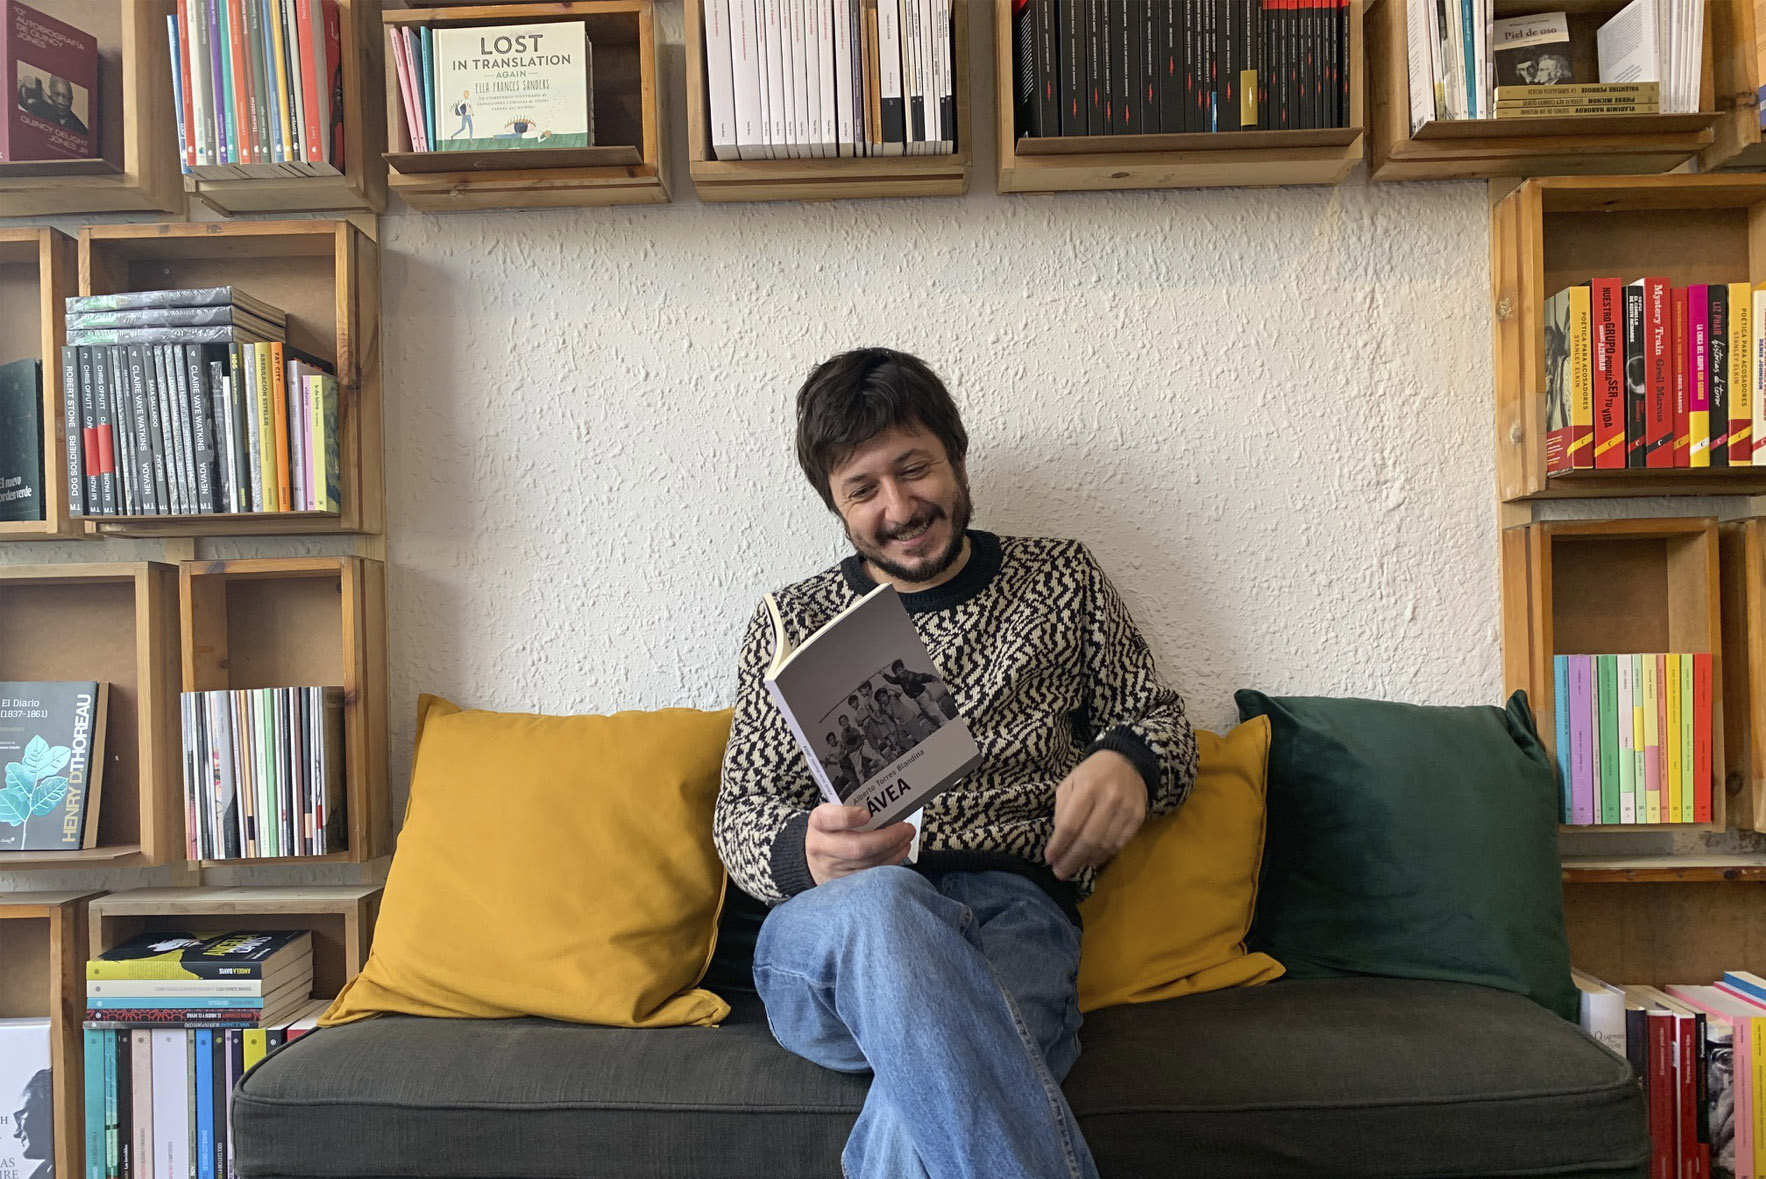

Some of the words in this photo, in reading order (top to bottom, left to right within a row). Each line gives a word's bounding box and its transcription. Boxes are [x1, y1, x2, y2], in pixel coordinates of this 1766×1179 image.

[29, 28, 63, 48] QUINCY
[480, 34, 543, 55] LOST
[1504, 29, 1524, 40] Piel
[1526, 29, 1538, 38] de
[453, 59, 467, 70] IN
[472, 54, 571, 69] TRANSLATION
[495, 70, 527, 79] AGAIN
[475, 82, 490, 94] ELLA
[492, 80, 520, 92] FRANCES
[523, 79, 550, 90] SANDERS
[20, 115, 53, 132] QUINCY
[1602, 287, 1612, 322] NUESTRO
[1653, 284, 1663, 325] Mystery
[1713, 301, 1721, 312] LIZ
[1713, 314, 1722, 335] PHAIR
[1605, 322, 1616, 354] GRUPO
[1655, 326, 1664, 356] Train
[66, 351, 72, 359] 1
[1712, 339, 1725, 373] historias
[66, 365, 75, 398] ROBERT
[83, 364, 91, 385] CHRIS
[132, 365, 141, 393] CLAIRE
[190, 365, 199, 392] CLAIRE
[260, 353, 268, 396] ABERRACIÓN
[1655, 358, 1664, 383] Greil
[1714, 375, 1725, 384] de
[84, 385, 93, 410] OFFUTT
[98, 385, 106, 410] OFFUTT
[1608, 380, 1618, 398] SER
[1714, 384, 1724, 407] terror
[67, 399, 76, 428] STONE
[135, 395, 144, 415] VAYE
[193, 395, 202, 414] VAYE
[1605, 398, 1612, 407] TU
[1656, 386, 1665, 423] Marcus
[1601, 408, 1613, 429] VIDA
[138, 416, 148, 451] WATKINS
[196, 416, 206, 451] WATKINS
[69, 435, 78, 476] SOLDIERS
[71, 476, 79, 497] DOG
[142, 462, 151, 494] NEVADA
[200, 462, 209, 494] NEVADA
[91, 493, 98, 501] MI
[104, 493, 111, 501] MI
[0, 710, 48, 718] (1837-1861)
[1, 699, 10, 707] El
[13, 699, 40, 707] Diario
[70, 694, 91, 771] THOREAU
[853, 785, 876, 805] Alberto
[876, 771, 897, 786] Torres
[896, 750, 925, 772] Blandina
[866, 778, 912, 818] ÁVEA
[62, 787, 82, 842] HENRY
[218, 967, 233, 975] DAVIS
[232, 967, 251, 975] ANGELA
